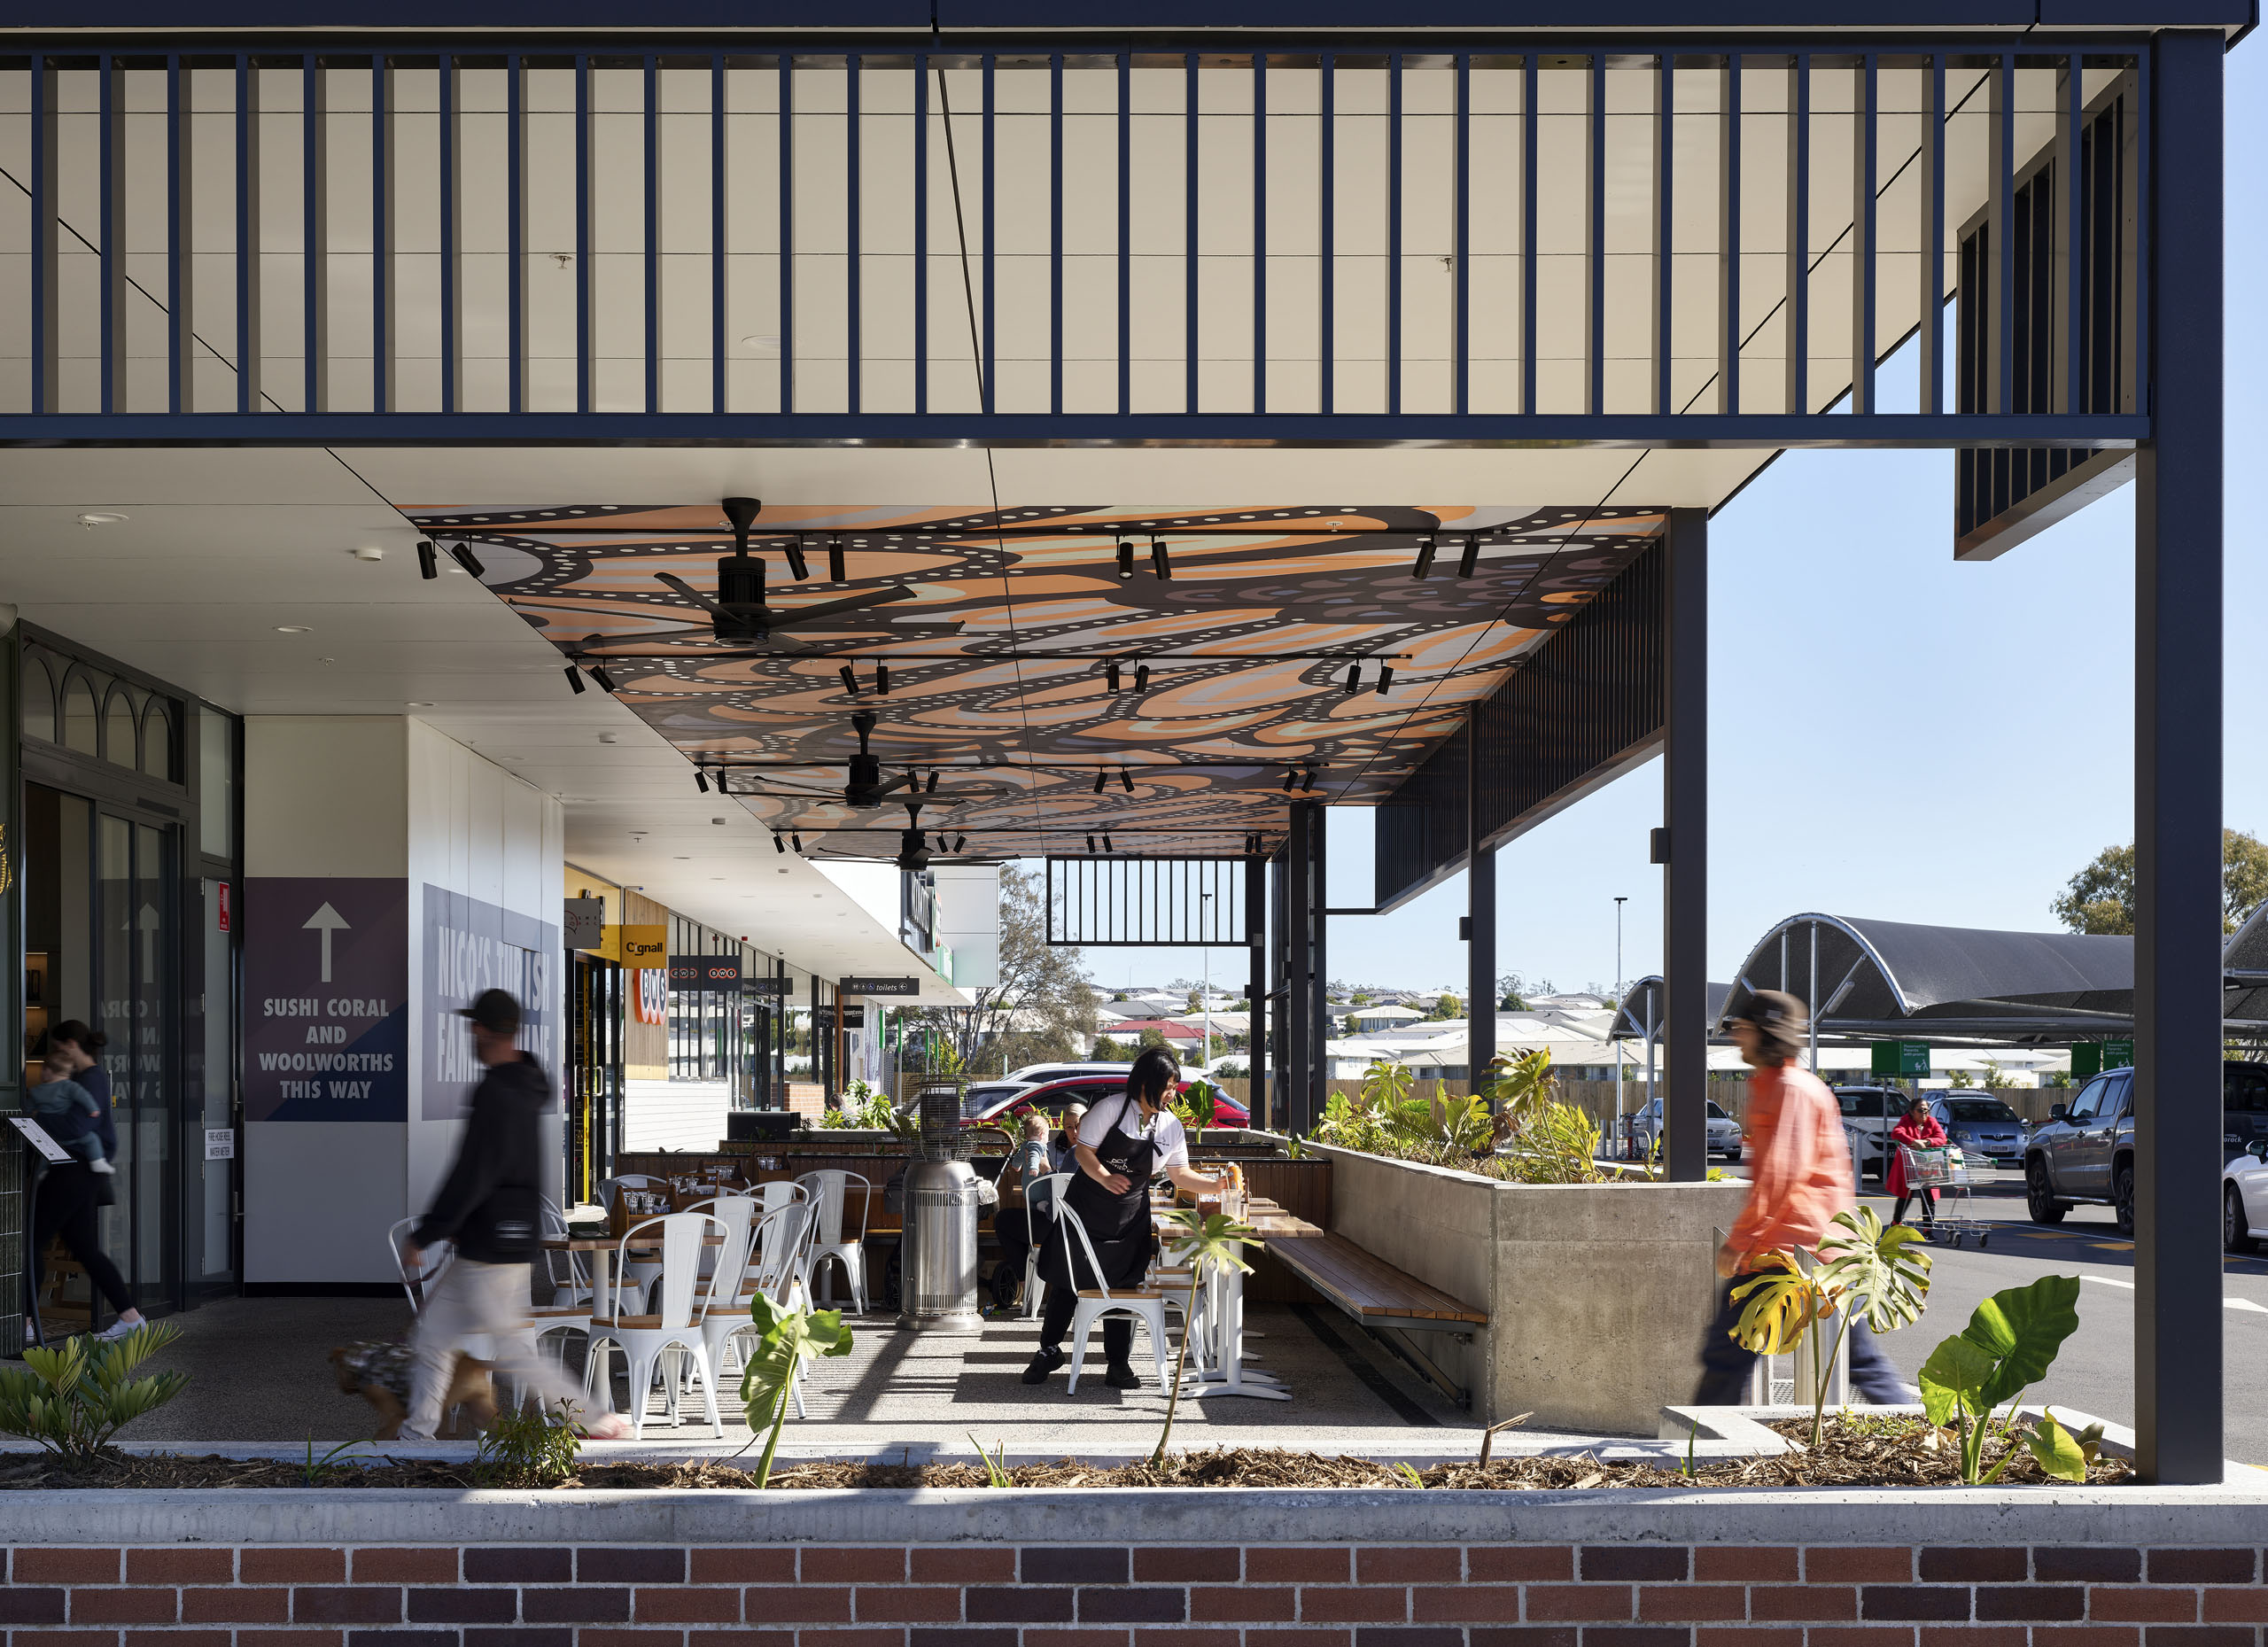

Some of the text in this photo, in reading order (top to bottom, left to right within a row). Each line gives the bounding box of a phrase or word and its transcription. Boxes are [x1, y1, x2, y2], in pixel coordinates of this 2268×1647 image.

[625, 942, 663, 956] Cignall
[438, 926, 491, 1001] NICO'S
[644, 973, 665, 1002] BWS
[263, 998, 390, 1017] SUSHI CORAL
[306, 1026, 346, 1044] AND
[259, 1053, 393, 1071] WOOLWORTHS
[280, 1080, 372, 1099] THIS WAY
